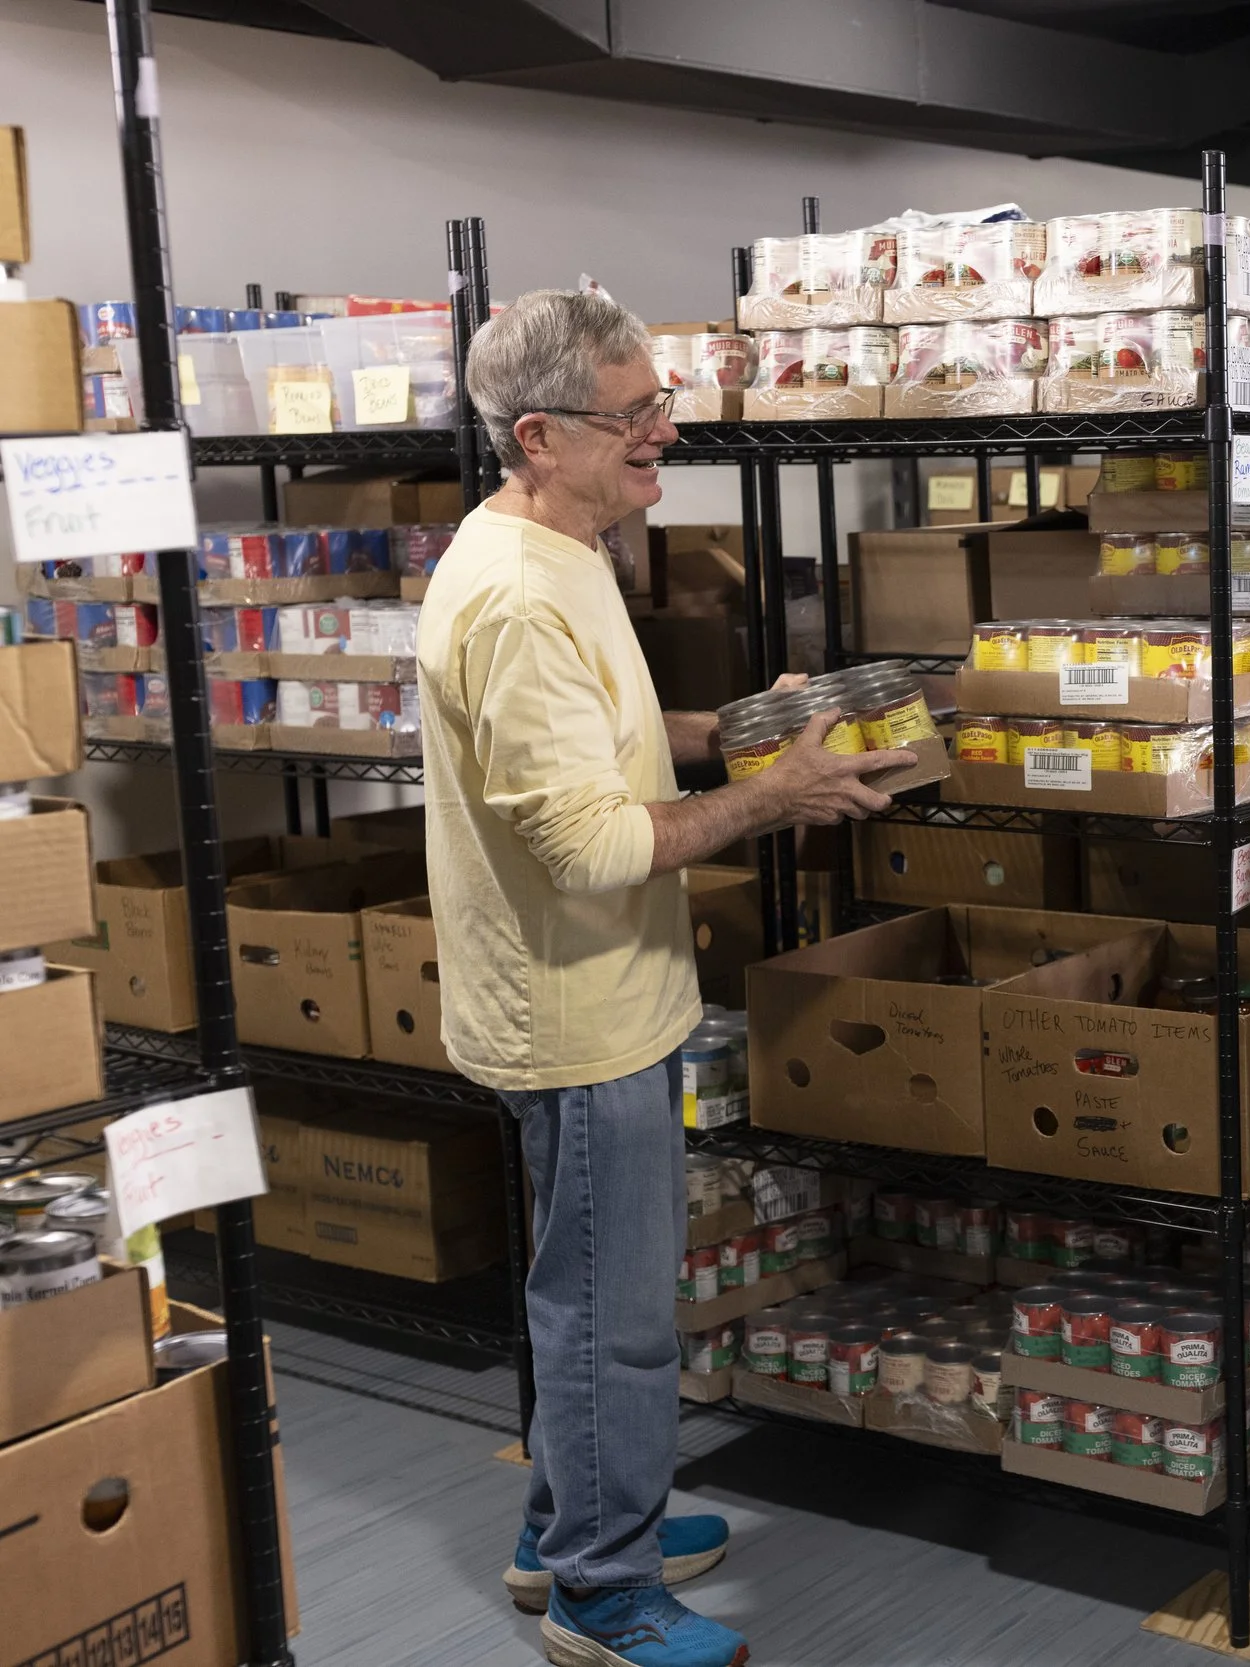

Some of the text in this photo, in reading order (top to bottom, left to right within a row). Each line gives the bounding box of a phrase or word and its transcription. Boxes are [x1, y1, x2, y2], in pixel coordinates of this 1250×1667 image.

[879, 240, 897, 251] MUI
[708, 340, 731, 352] MUIR
[1140, 393, 1196, 407] SAUCE
[1002, 1008, 1212, 1044] OTHER TOMATO ITEMS
[1105, 1055, 1127, 1067] GLEN
[1074, 1091, 1121, 1109] PASTE
[1176, 1347, 1208, 1359] QUALITA
[1180, 1343, 1206, 1352] PRIMA
[801, 1367, 826, 1376] DICED
[1179, 1373, 1207, 1381] DICED
[1170, 1378, 1214, 1388] TOMATOES
[1172, 1433, 1196, 1441] PRIMA
[1168, 1438, 1199, 1450] QUALITA
[1170, 1462, 1196, 1470] DICED
[115, 1625, 134, 1662] 13
[140, 1613, 158, 1646] 14
[163, 1600, 182, 1635] 15
